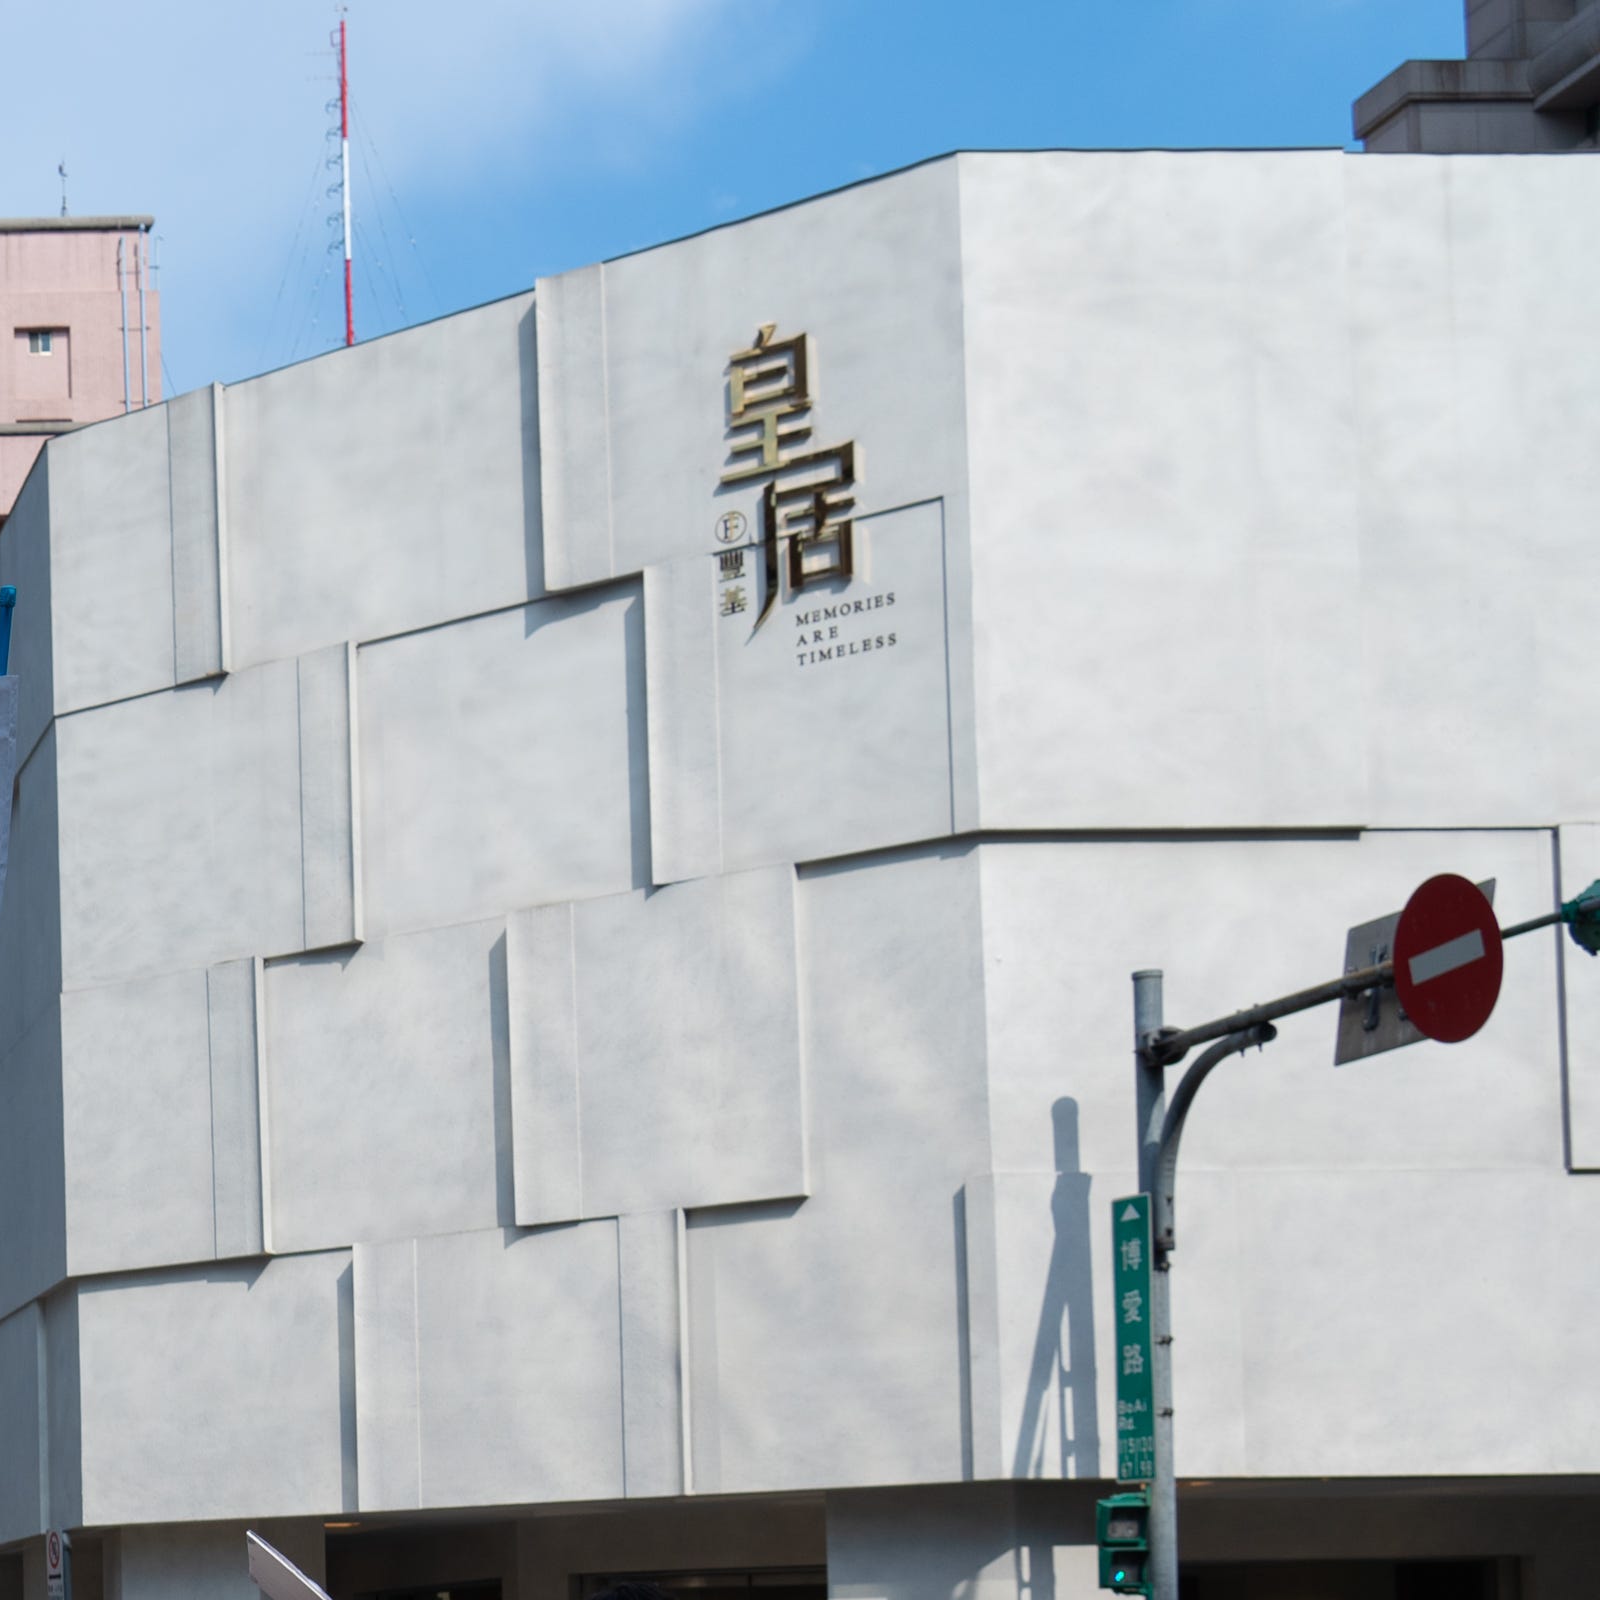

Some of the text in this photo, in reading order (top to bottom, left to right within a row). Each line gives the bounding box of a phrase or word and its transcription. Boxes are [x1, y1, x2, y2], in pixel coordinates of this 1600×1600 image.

[718, 323, 856, 646] 皇居
[795, 592, 897, 627] MEMORIES
[796, 626, 840, 647] ARE
[796, 632, 899, 666] TIMELESS
[1120, 1238, 1144, 1376] 博愛路
